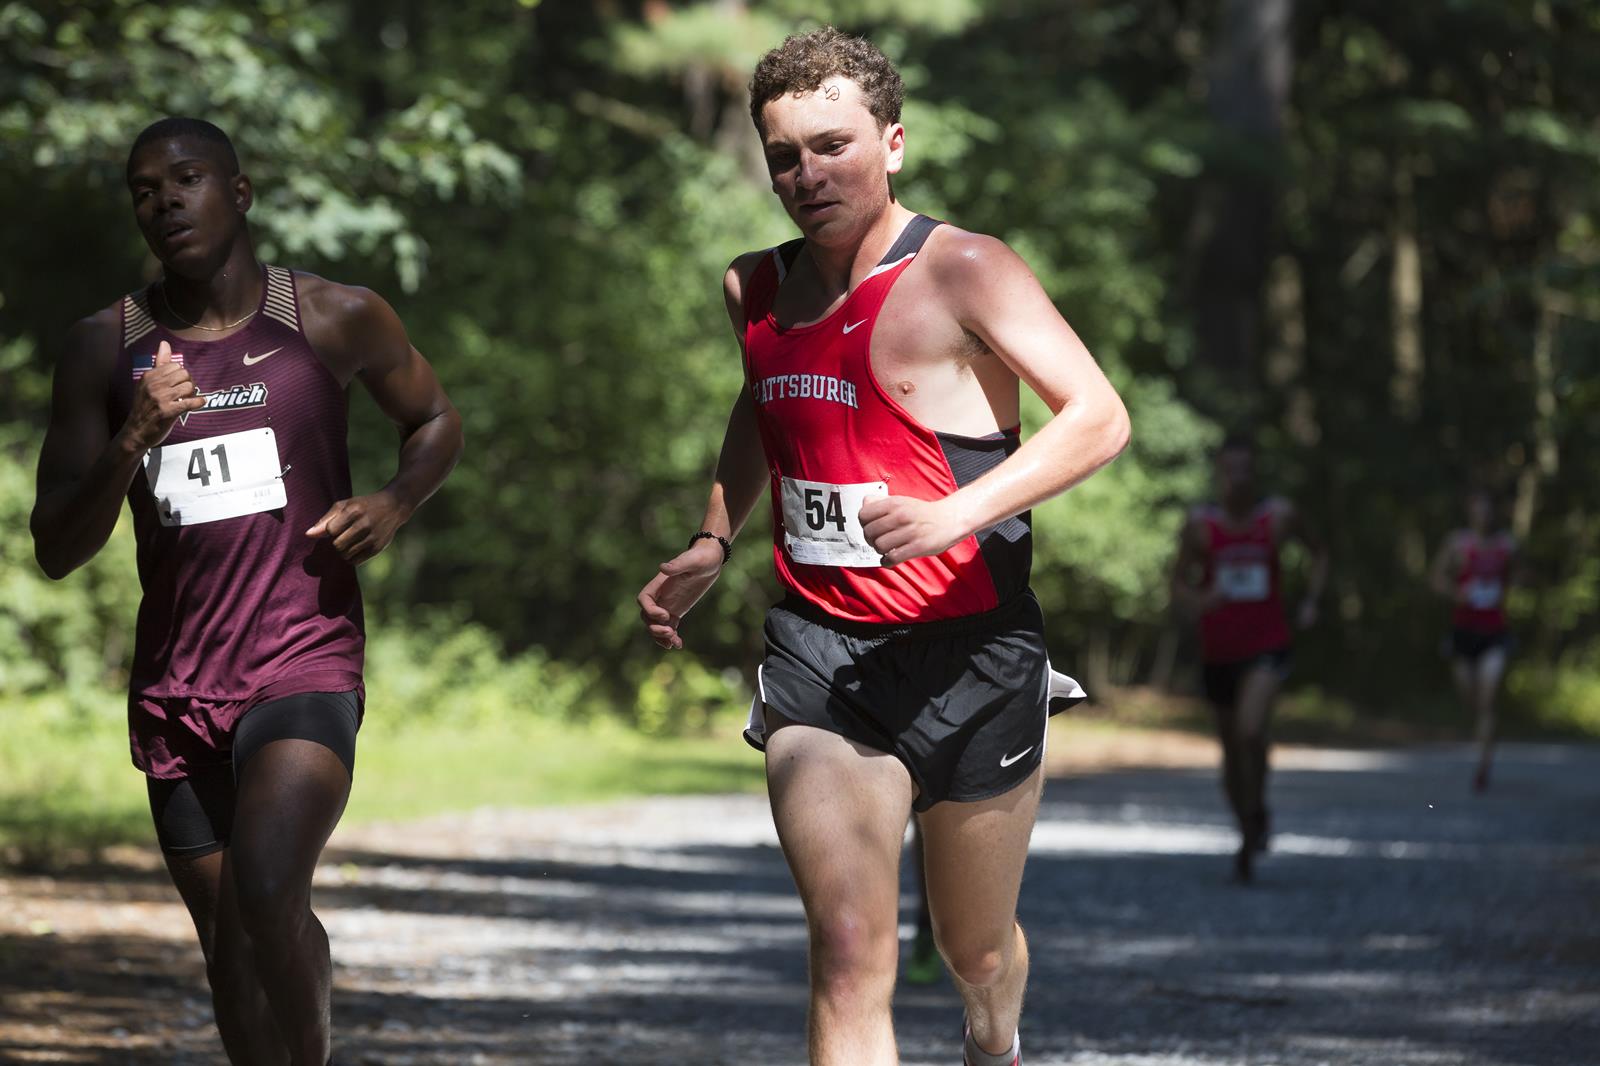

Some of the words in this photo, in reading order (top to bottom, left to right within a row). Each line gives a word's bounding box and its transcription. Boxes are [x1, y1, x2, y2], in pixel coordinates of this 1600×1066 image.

[203, 385, 265, 408] rwich
[753, 374, 859, 409] ATTSBURGH
[187, 443, 232, 487] 41
[804, 488, 847, 532] 54
